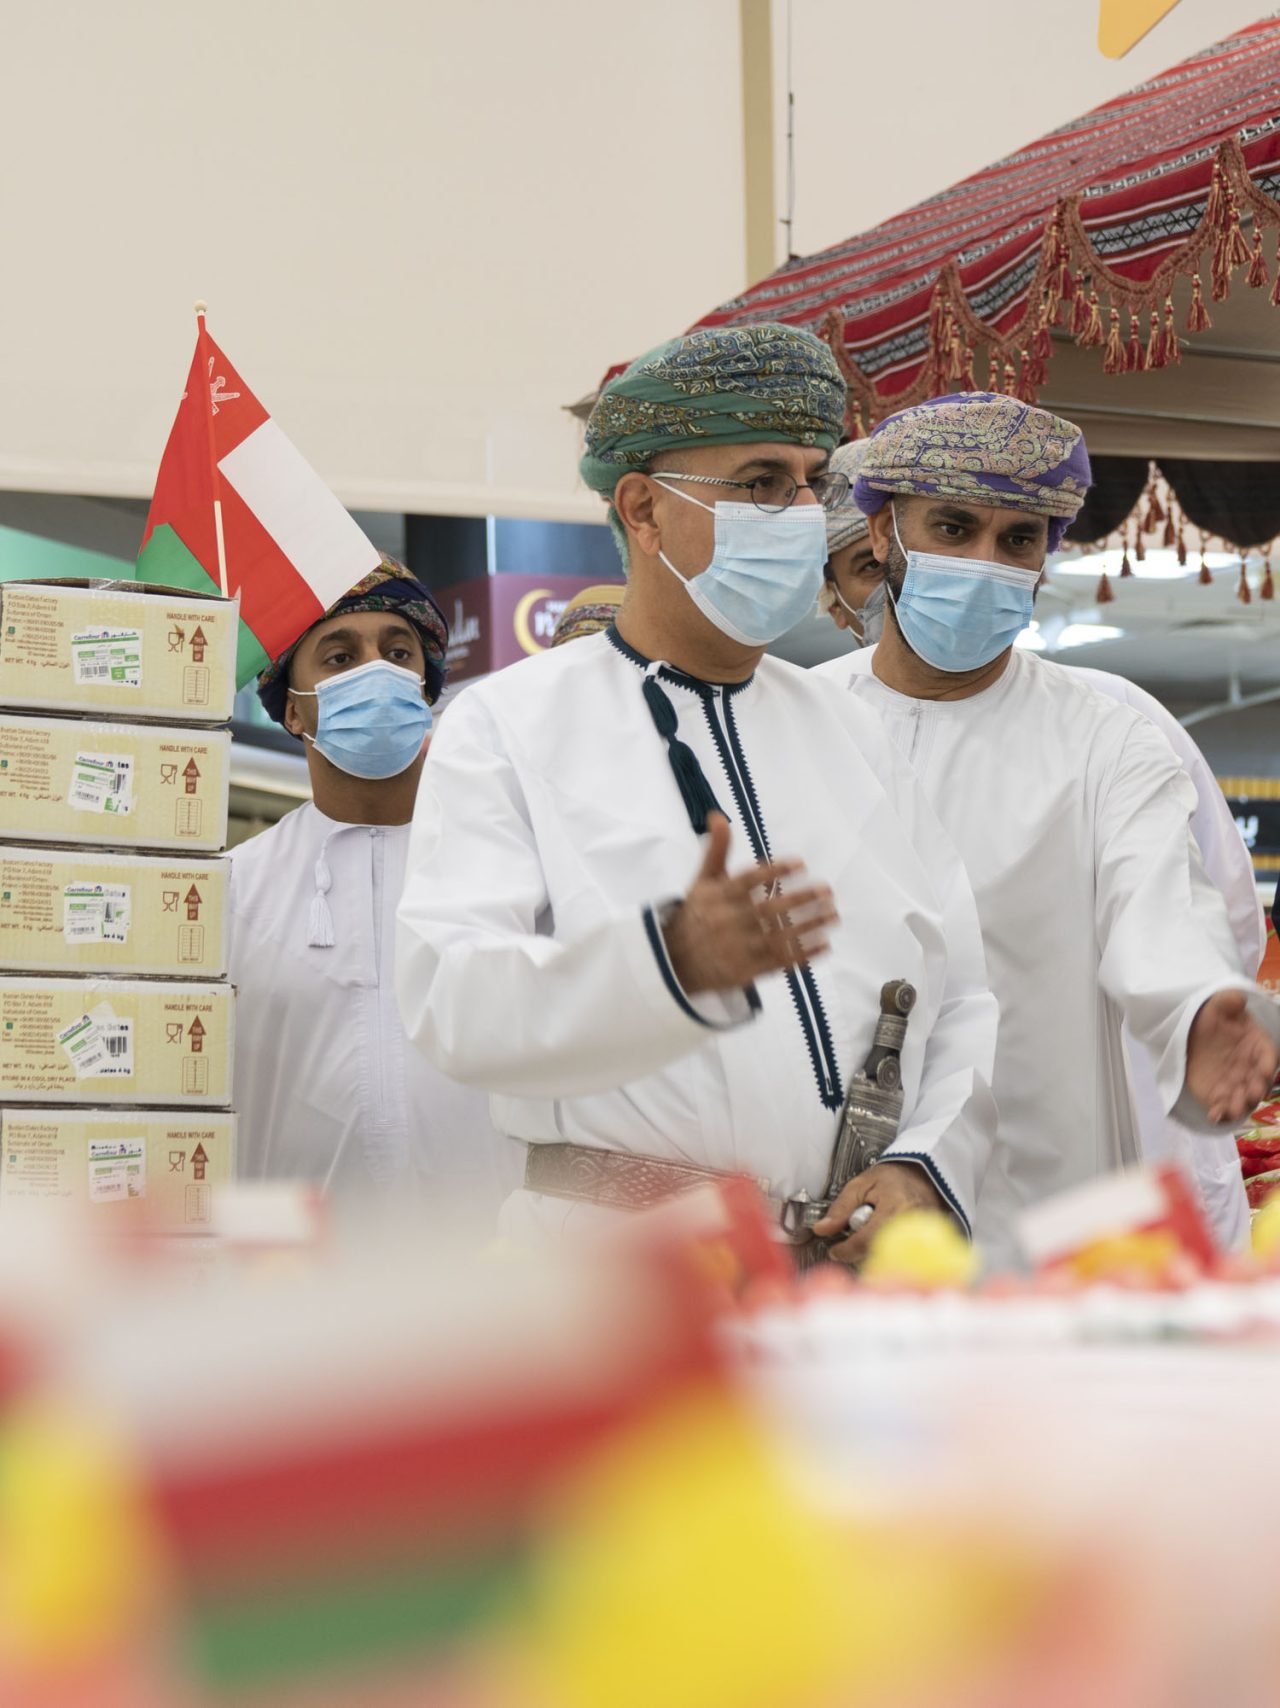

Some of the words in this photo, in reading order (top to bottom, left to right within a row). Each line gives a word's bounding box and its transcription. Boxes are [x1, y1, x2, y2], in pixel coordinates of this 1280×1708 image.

[166, 612, 187, 621] HANDLE
[201, 614, 216, 622] CARE
[159, 744, 180, 753] HANDLE
[181, 745, 193, 753] WITH
[194, 746, 208, 754] CARE
[79, 756, 105, 766] Carrefour
[161, 871, 181, 880] HANDLE
[182, 872, 195, 880] WITH
[195, 873, 209, 881] CARE
[164, 1003, 185, 1011] HANDLE
[186, 1004, 199, 1012] WITH
[199, 1004, 213, 1012] CARE
[59, 1022, 82, 1040] Carrefour
[167, 1131, 187, 1139] HANDLE
[188, 1131, 200, 1139] WITH
[201, 1131, 215, 1139] CARE
